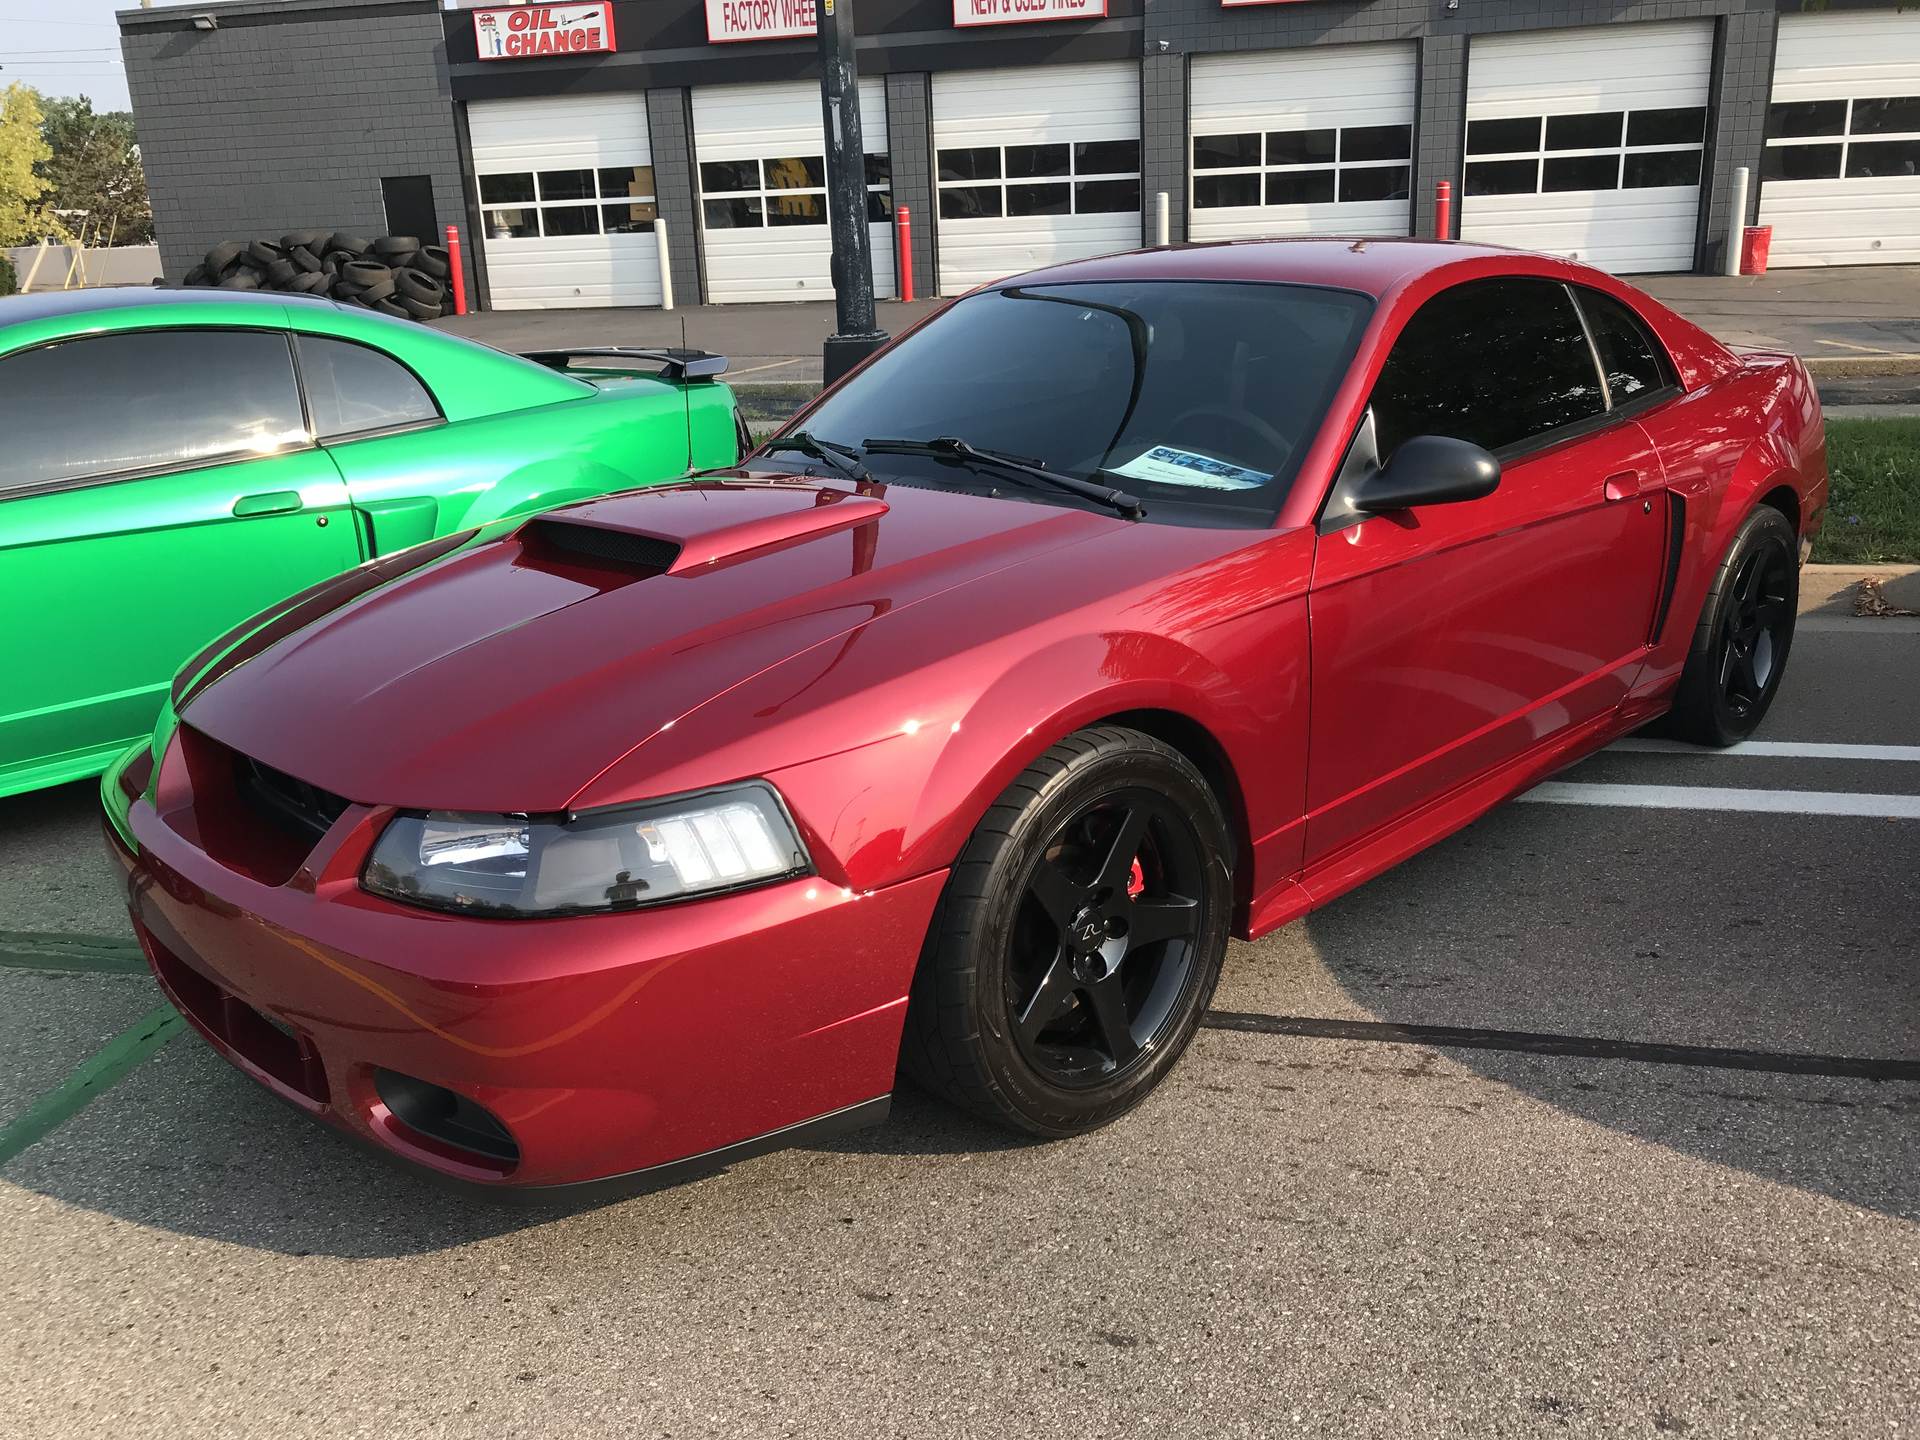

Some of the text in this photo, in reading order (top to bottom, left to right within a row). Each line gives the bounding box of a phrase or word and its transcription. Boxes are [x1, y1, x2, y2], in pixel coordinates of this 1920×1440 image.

[507, 9, 558, 32] OIL
[723, 0, 781, 33] FACTORY
[505, 27, 601, 55] CHANGE
